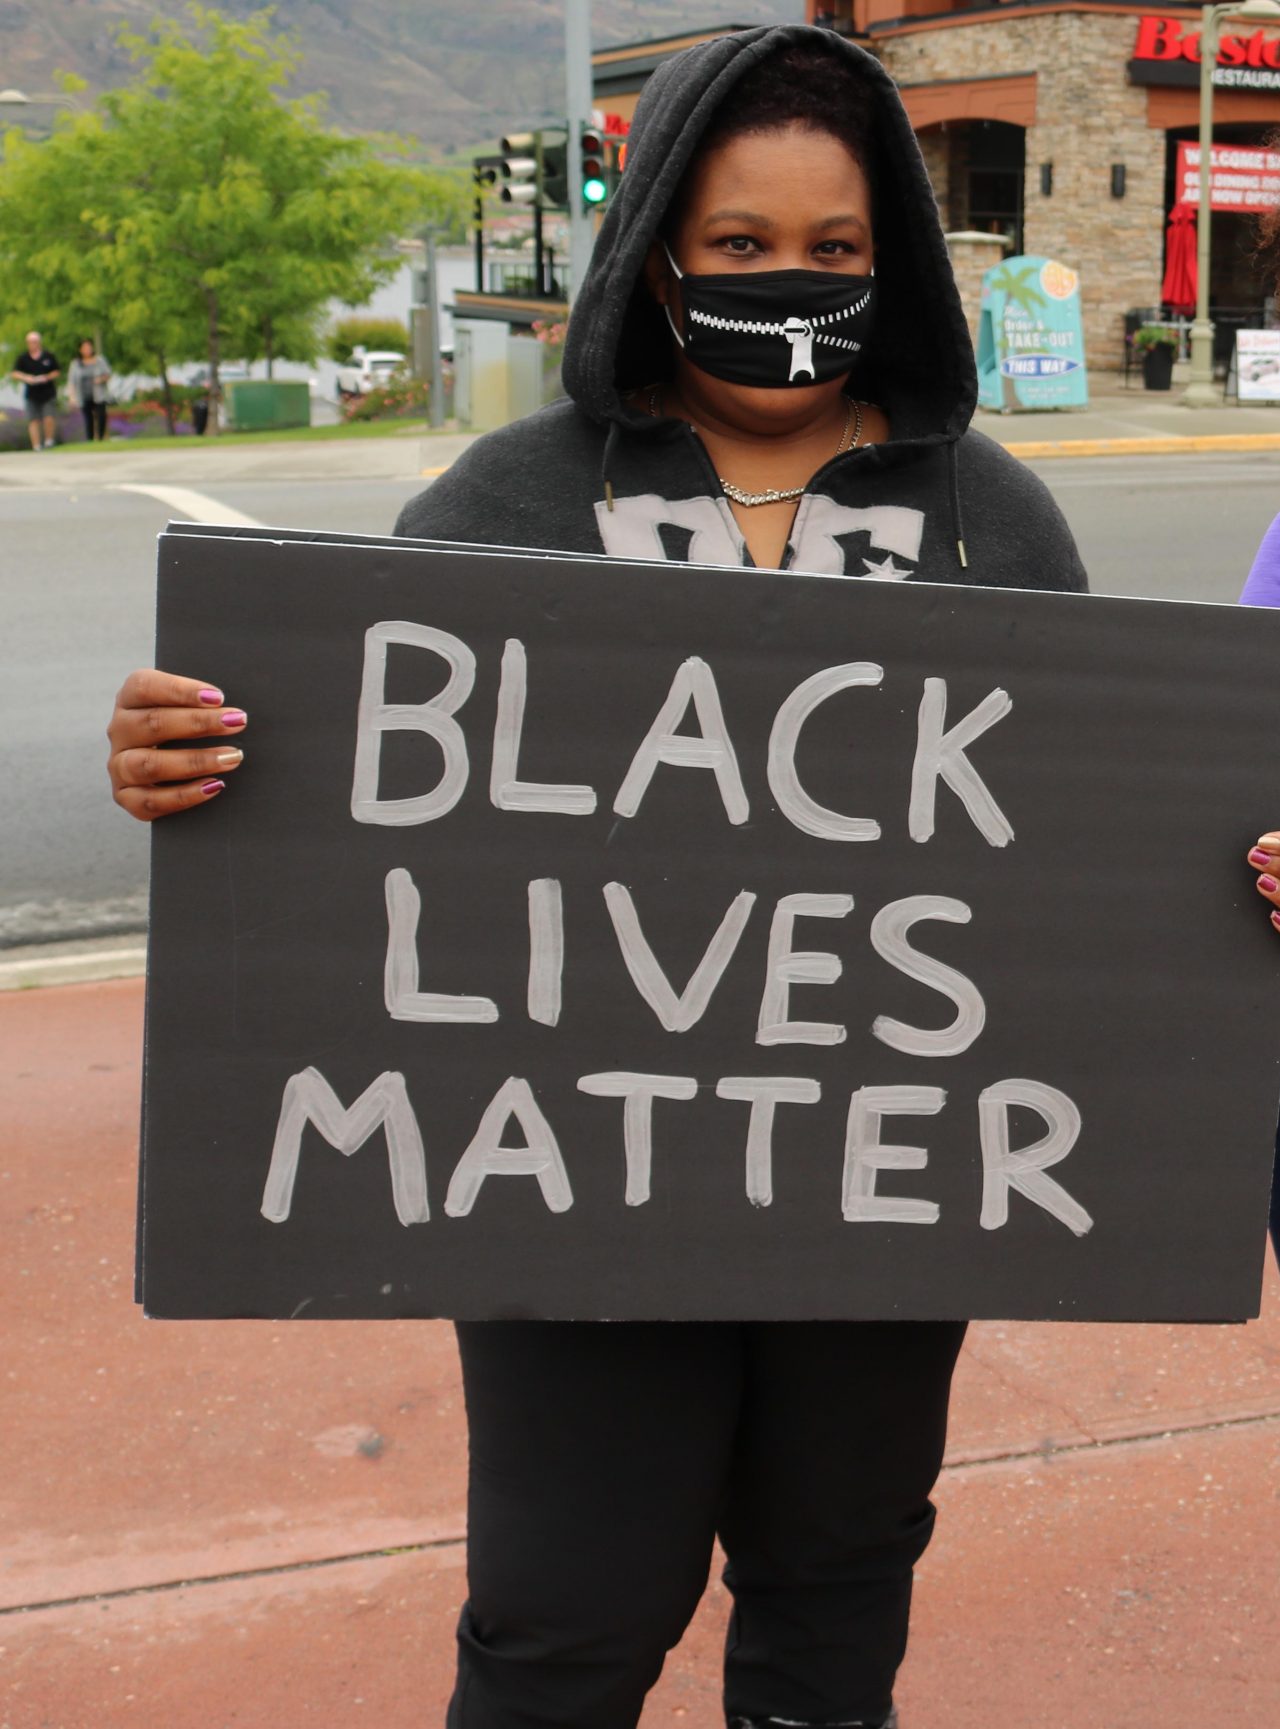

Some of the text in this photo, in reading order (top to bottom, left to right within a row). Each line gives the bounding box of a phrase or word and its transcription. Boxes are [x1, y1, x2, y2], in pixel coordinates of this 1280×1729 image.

[1183, 171, 1213, 187] OU
[1184, 148, 1264, 170] WLCOME
[1008, 359, 1067, 374] THIS WAY
[351, 620, 1015, 848] BLACK
[385, 867, 986, 1058] LIVES
[260, 1065, 1094, 1237] MATTER
